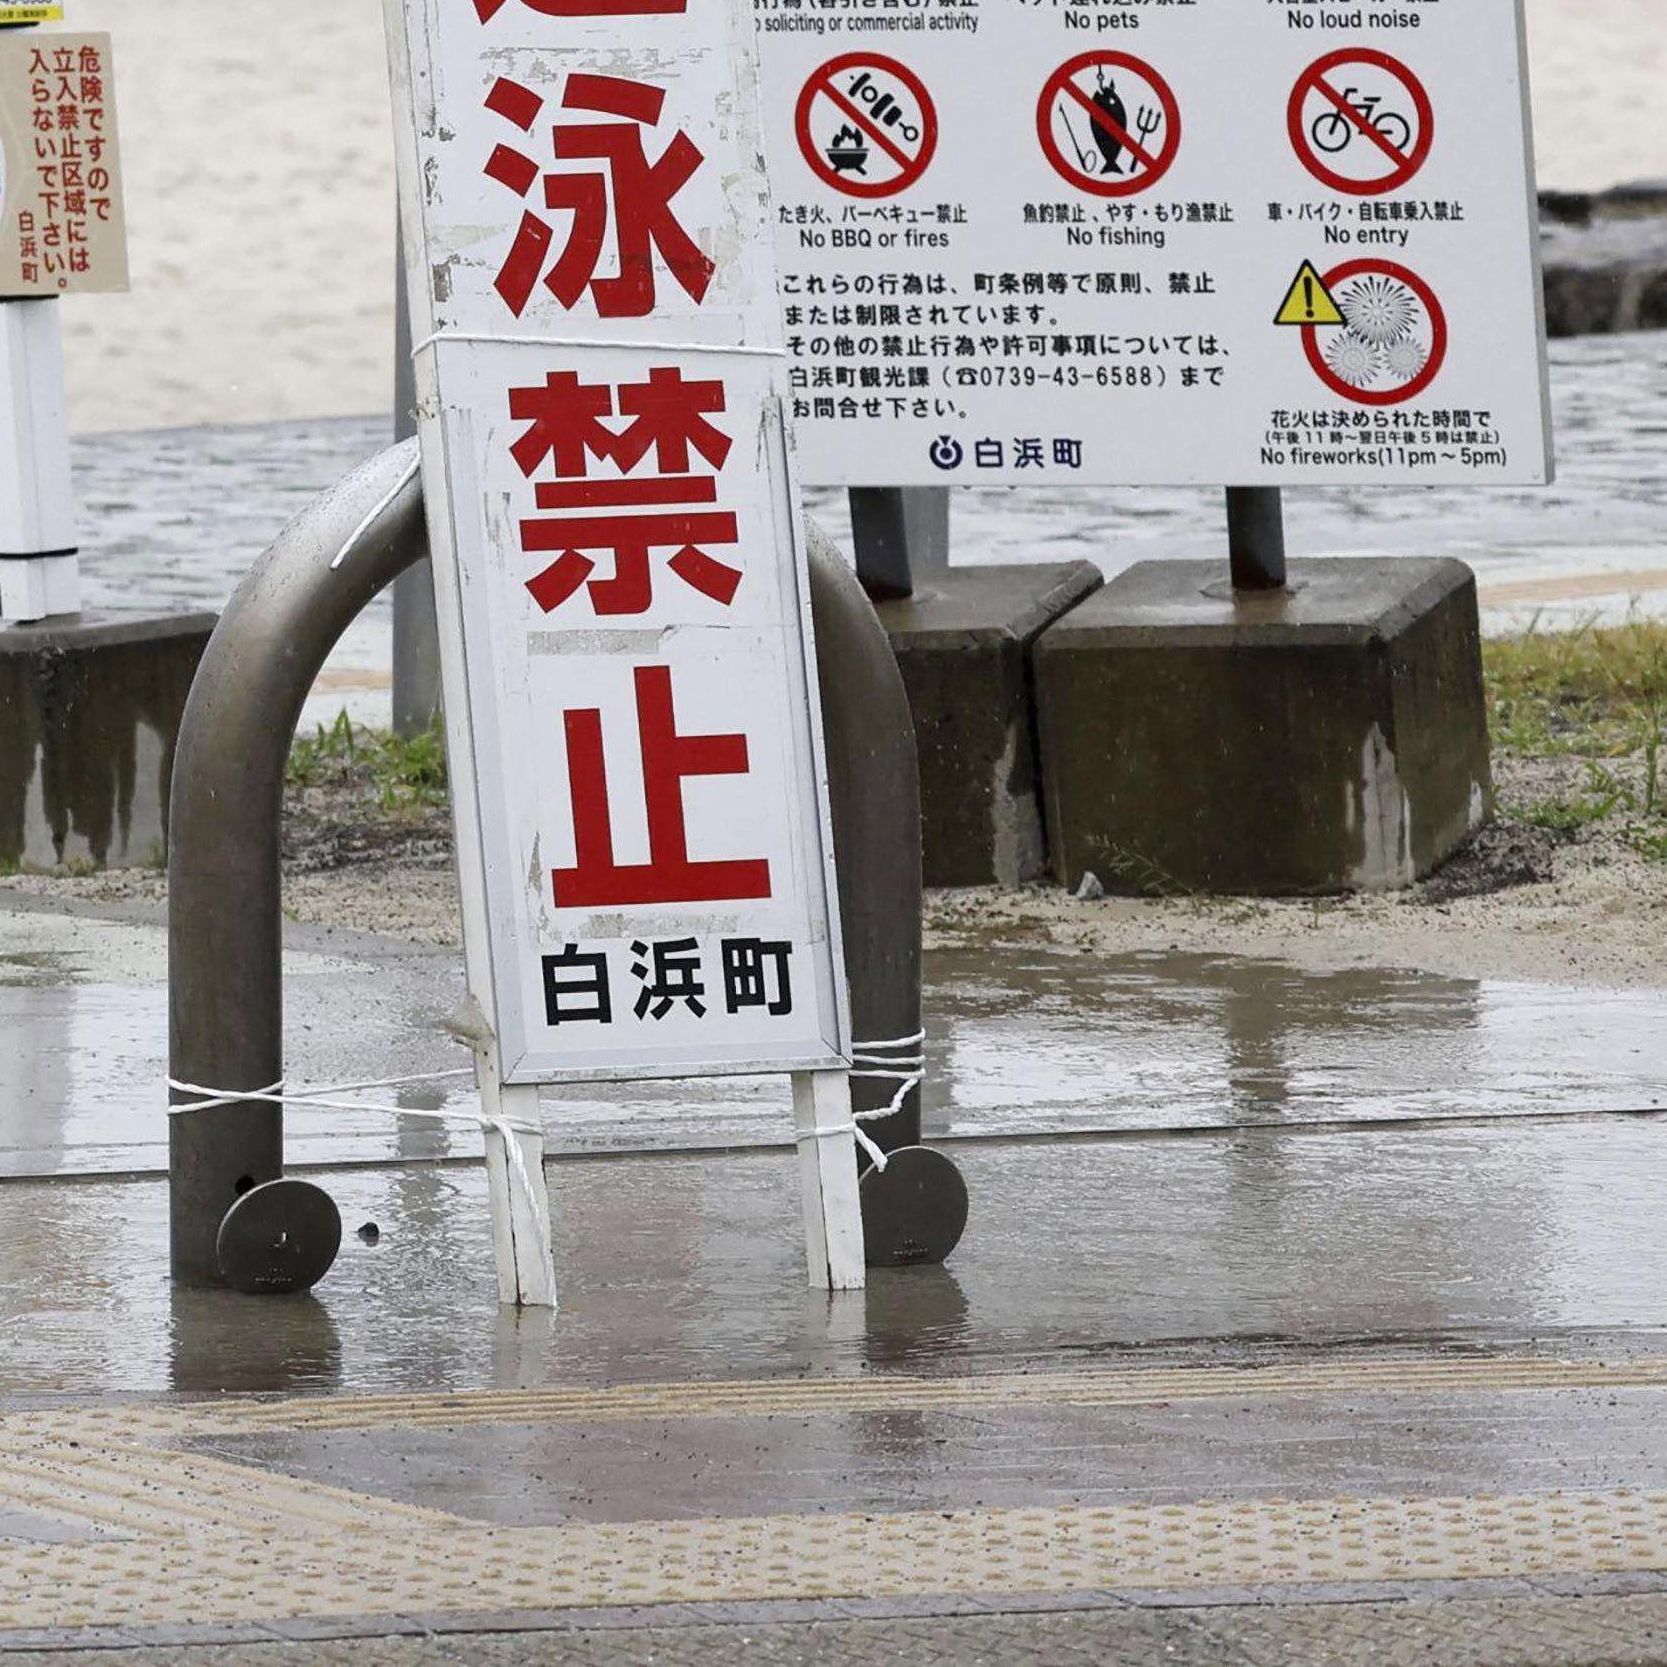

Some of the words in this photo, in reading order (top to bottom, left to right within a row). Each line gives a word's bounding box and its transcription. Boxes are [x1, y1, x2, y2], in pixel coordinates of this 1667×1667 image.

[765, 14, 824, 35] soliciting
[829, 17, 842, 31] or
[847, 13, 925, 31] commercial
[929, 12, 978, 33] activity
[1065, 11, 1090, 29] No
[1097, 12, 1139, 32] pets
[1288, 10, 1314, 28] No
[1321, 10, 1362, 28] loud
[1369, 9, 1420, 28] noise
[78, 45, 111, 222] 危険ですので
[28, 47, 68, 288] 入らないで下さい。
[53, 46, 91, 273] 立入禁止区域には
[779, 204, 967, 224] たき火、バーベキュー禁止
[1268, 201, 1463, 221] 車・バイク・自転車乗入禁止
[18, 210, 39, 283] 白浜町
[800, 230, 825, 247] No
[832, 229, 871, 247] BBQ
[878, 233, 898, 247] or
[904, 229, 949, 247] fires
[1067, 227, 1092, 245] No
[1099, 226, 1165, 248] fishing
[1325, 225, 1350, 243] No
[1357, 227, 1408, 247] entry
[784, 272, 1215, 295] これらの行為は、町条例等で原則、禁止
[786, 304, 1056, 326] または制限されています。
[787, 334, 1228, 357] その他の禁止行為や許可事項については、
[793, 397, 966, 418] お問合せ下さい。
[1272, 410, 1490, 428] 花火は決められた時間で
[975, 437, 1082, 468] 白浜町
[1261, 448, 1284, 464] No
[1461, 447, 1506, 467] 5pm)
[541, 937, 792, 1026] 白浜町
